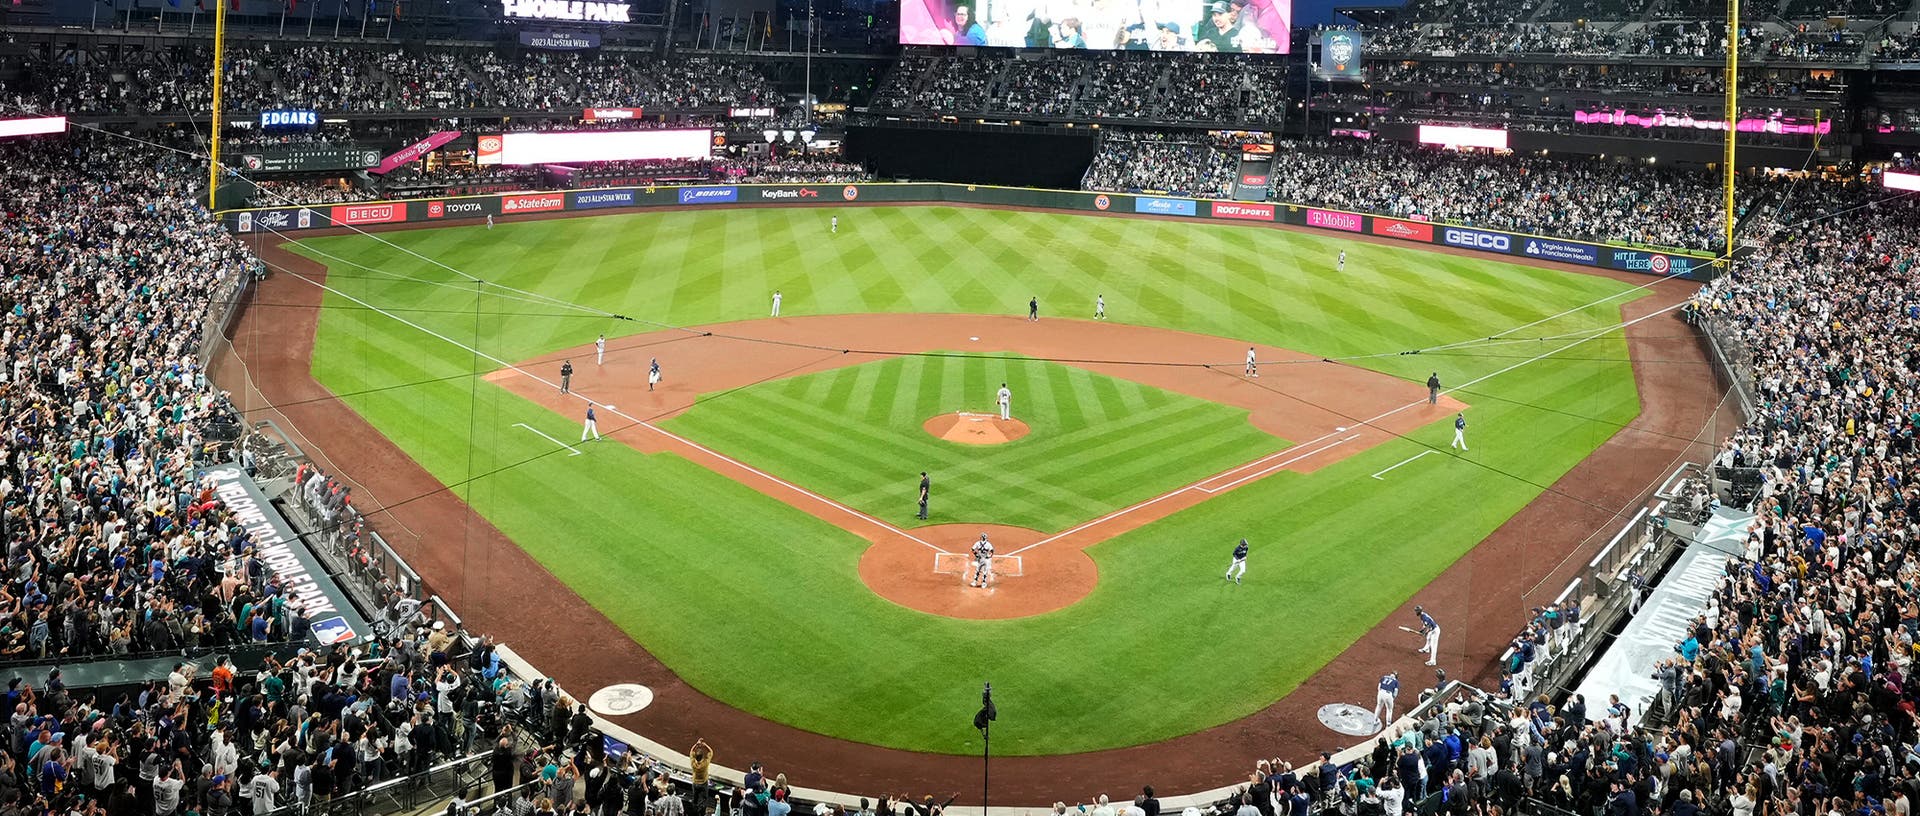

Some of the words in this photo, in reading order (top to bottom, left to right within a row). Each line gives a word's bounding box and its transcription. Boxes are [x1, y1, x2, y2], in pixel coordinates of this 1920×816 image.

[585, 2, 631, 22] PARK
[531, 38, 546, 47] 2023
[573, 39, 590, 48] WEEK
[615, 193, 631, 201] WEEK
[762, 189, 798, 199] KeyBank
[446, 203, 481, 212] TOYOTA
[1217, 205, 1241, 215] ROOT
[350, 209, 389, 219] BECU
[1446, 230, 1509, 250] GEICO
[1541, 243, 1563, 251] Virginia
[1541, 249, 1572, 258] Franciscan
[1573, 253, 1594, 261] Health
[1614, 252, 1628, 260] HIT
[1629, 252, 1637, 260] IT
[1627, 260, 1648, 268] HERE
[1670, 259, 1687, 268] WIN
[217, 481, 268, 528] WELCOME
[264, 537, 313, 583] T-MOBILE
[298, 582, 338, 618] PARK
[255, 787, 265, 799] 51
